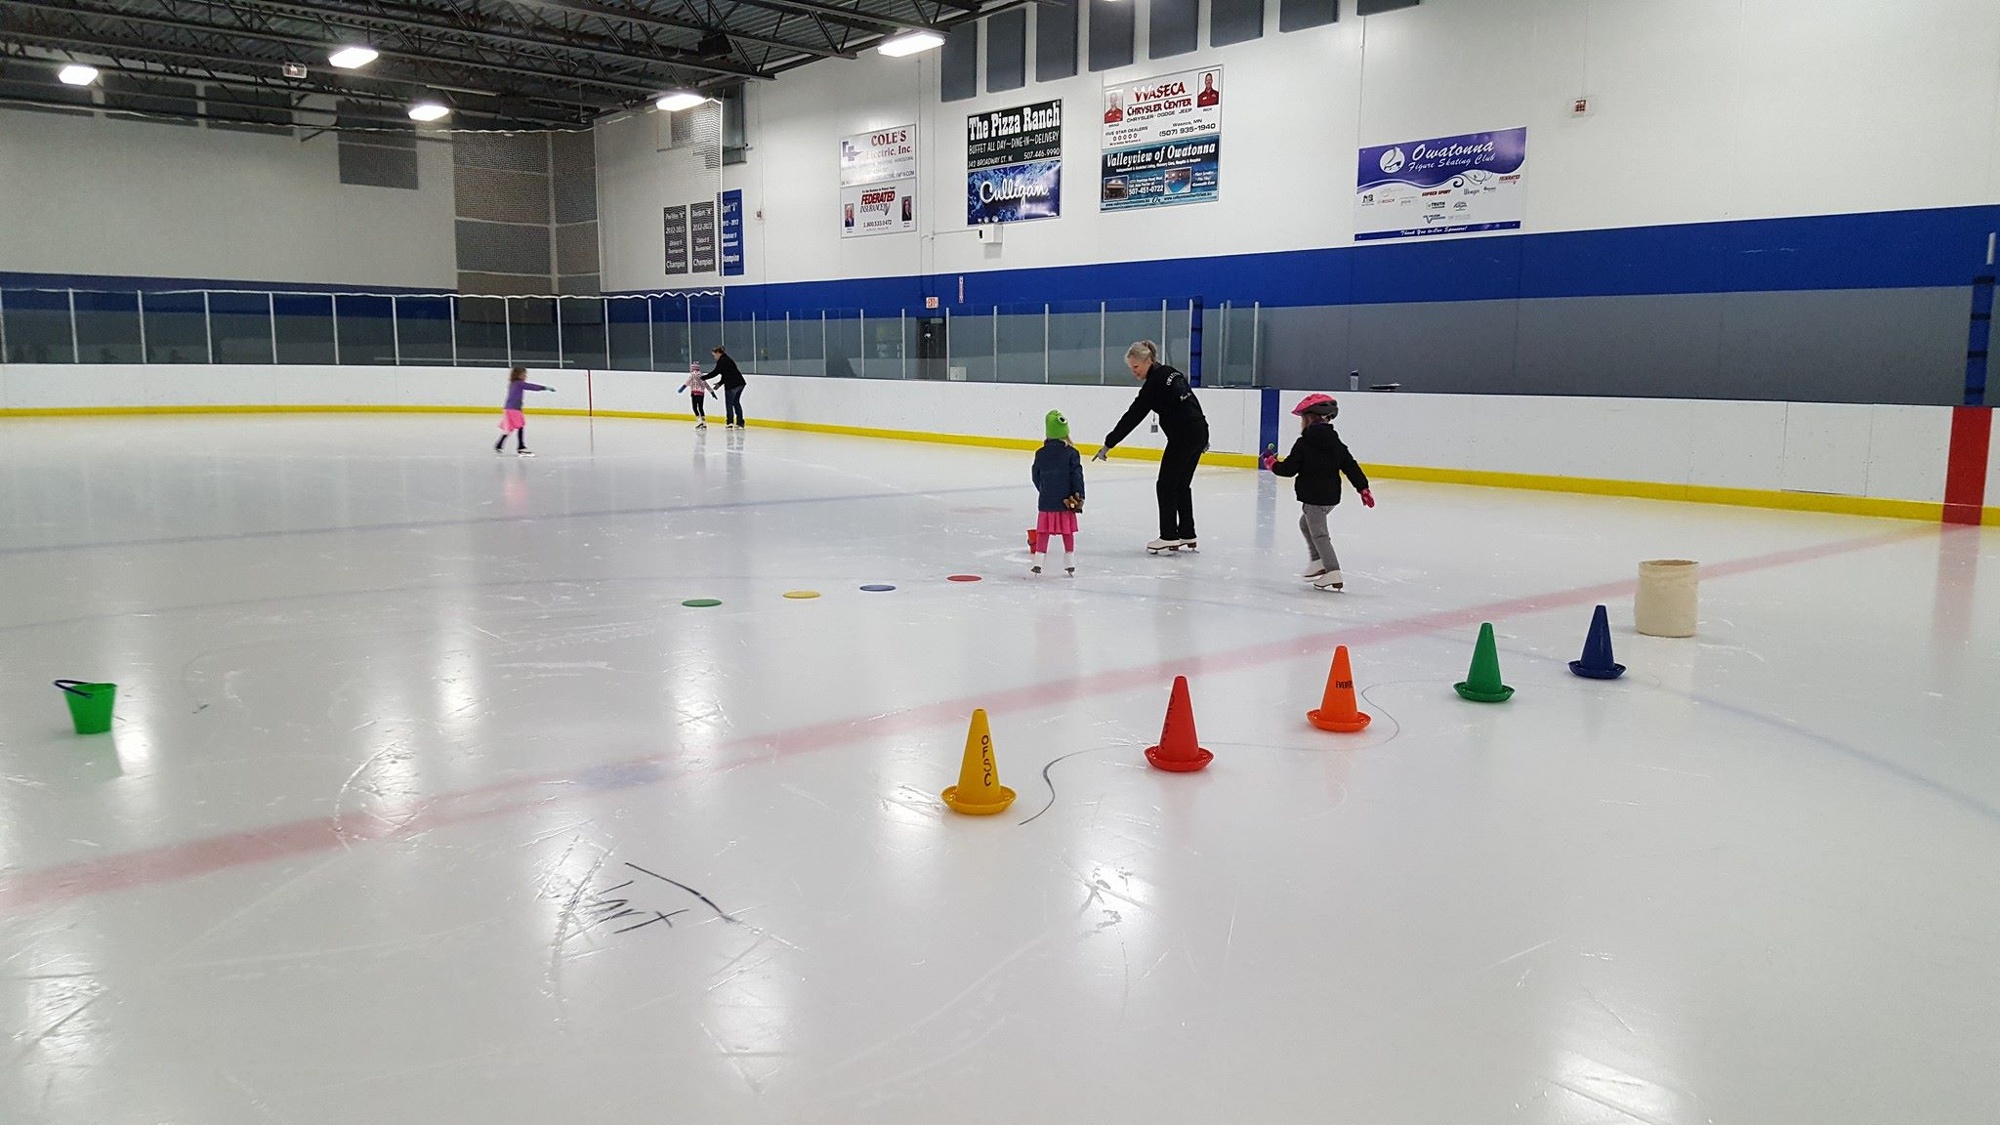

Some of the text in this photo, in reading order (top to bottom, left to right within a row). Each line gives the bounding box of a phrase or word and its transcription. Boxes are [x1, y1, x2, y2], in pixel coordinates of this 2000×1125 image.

[1133, 82, 1186, 102] WASECA
[1127, 98, 1192, 116] CHRYSLER CENTER
[969, 101, 1060, 141] The Pizza Ranch
[1180, 123, 1216, 134] 935-1940
[871, 130, 907, 147] COLE'S
[969, 143, 987, 155] BUFFET
[987, 141, 996, 152] ALL
[898, 145, 912, 155] Inc.
[1107, 142, 1216, 168] Valleyview of Owatonna
[1411, 140, 1495, 161] Owatonna
[1407, 152, 1496, 172] Figure Skating Club
[861, 190, 896, 205] FEDERATED
[980, 178, 1049, 206] Culligan
[1417, 228, 1426, 236] You
[981, 734, 992, 787] OFSC
